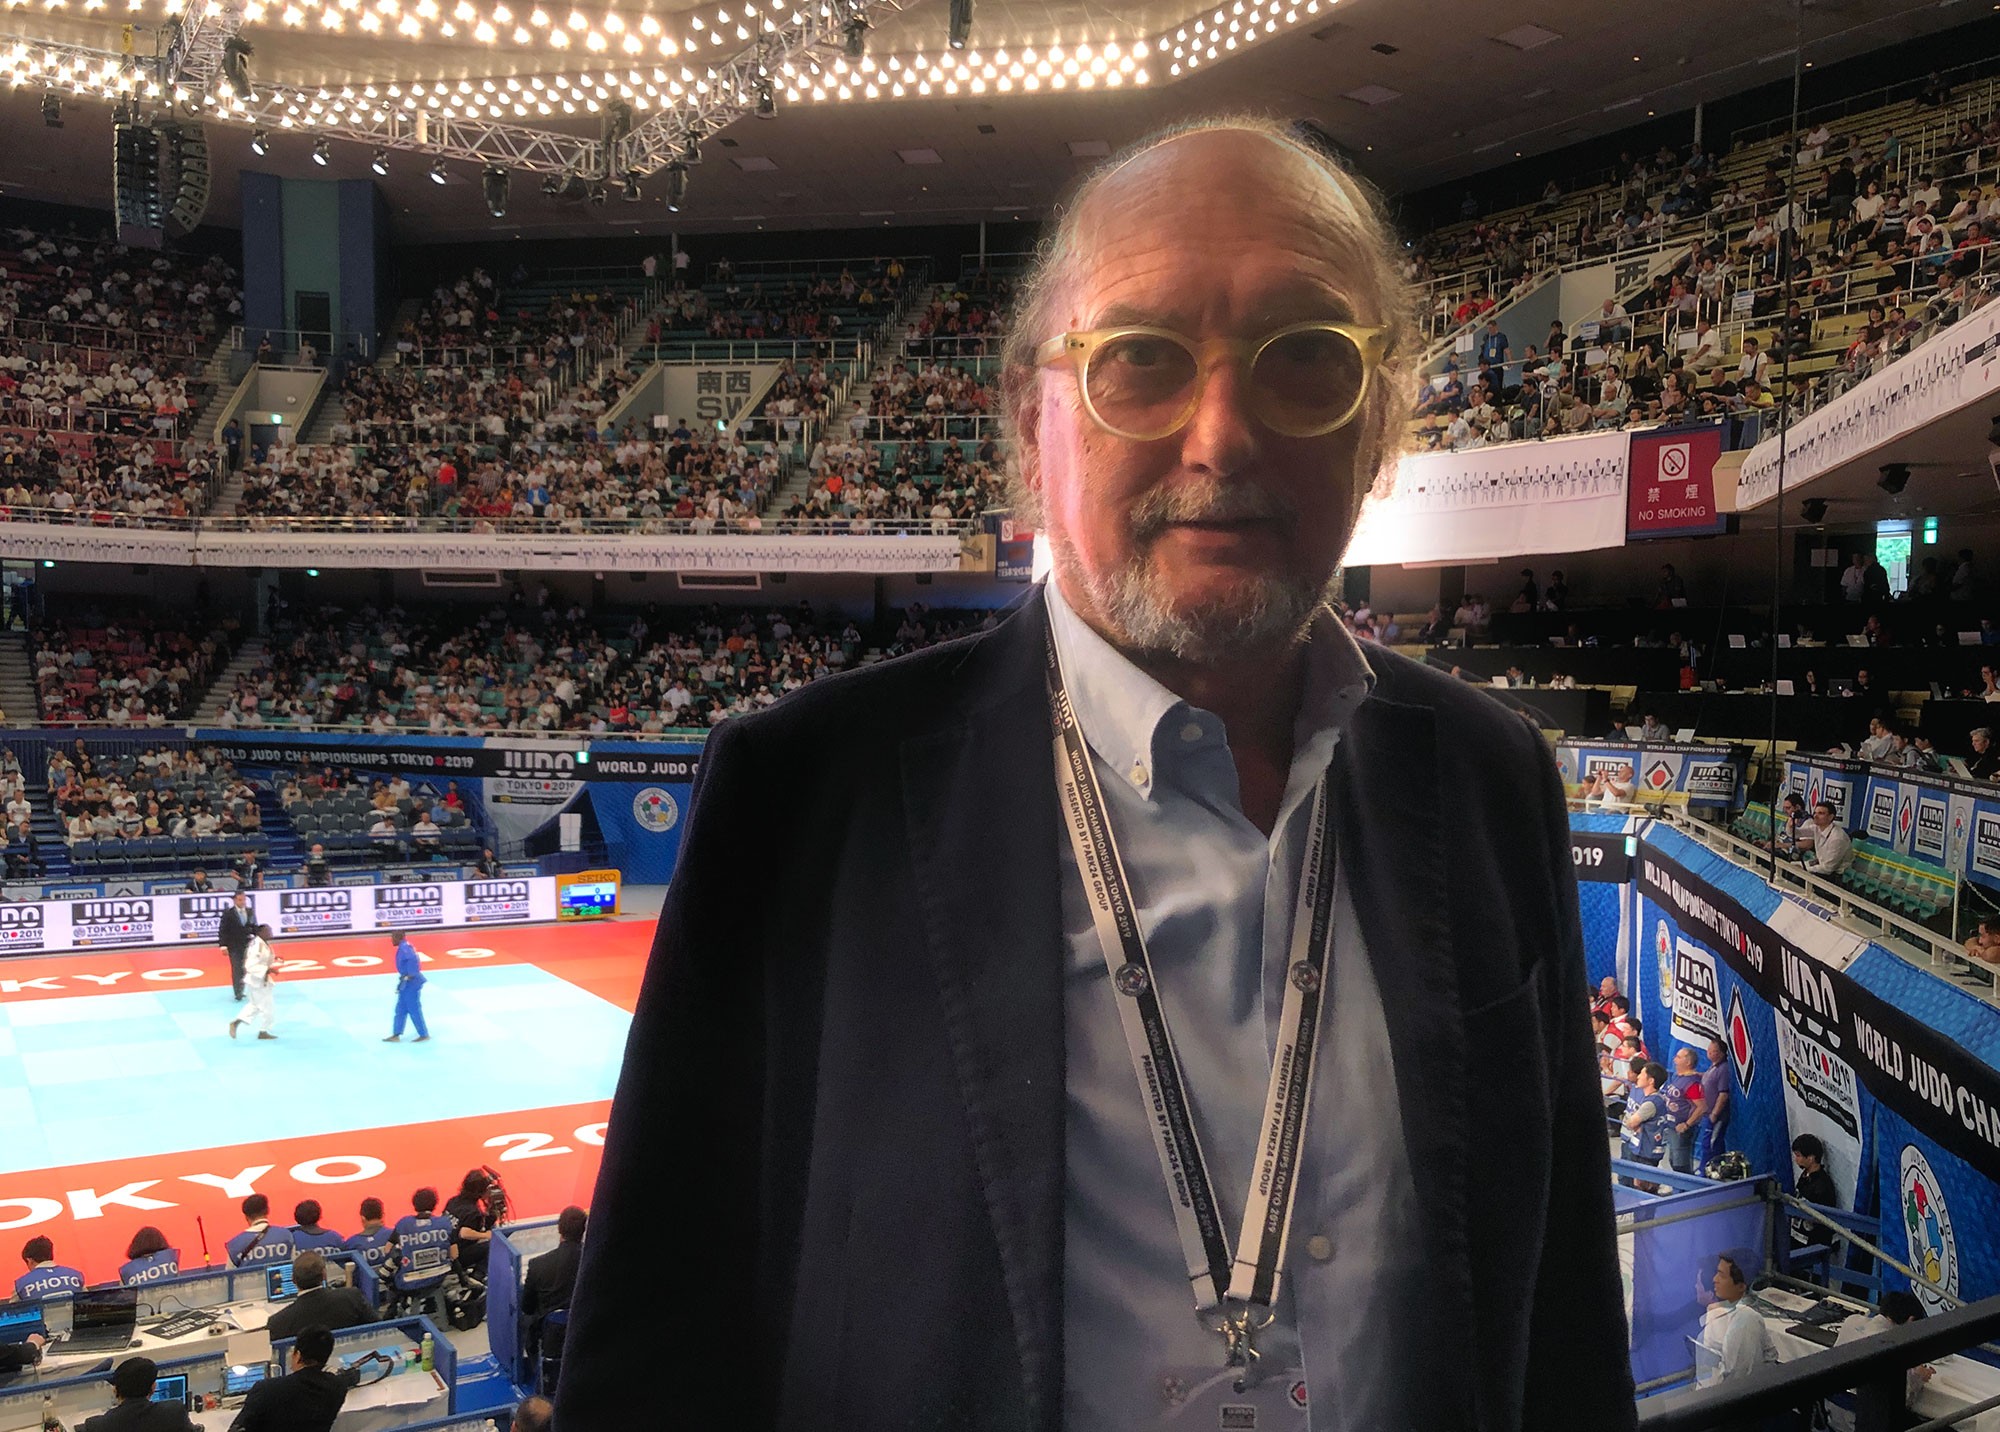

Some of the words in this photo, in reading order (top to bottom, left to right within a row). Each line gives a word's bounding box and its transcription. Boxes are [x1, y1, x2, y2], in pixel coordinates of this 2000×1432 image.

[697, 371, 751, 394] 南西
[697, 397, 751, 420] SW
[1638, 510, 1654, 520] NO
[1657, 506, 1706, 519] SMOKING
[225, 748, 246, 760] RLD
[251, 749, 281, 761] JUDO
[391, 753, 433, 766] TOKYO
[444, 755, 474, 768] 2019
[496, 752, 575, 778] JUDO
[597, 760, 647, 774] WORLD
[651, 762, 687, 775] JUDO
[1069, 748, 1086, 782] WORLD
[507, 780, 542, 790] TOKYO
[1079, 781, 1094, 806] JUDO
[1064, 781, 1085, 830] PRESENTED
[1078, 830, 1088, 843] BY
[1086, 806, 1115, 882] CHAMPIONSHIPS
[1313, 826, 1321, 837] BY
[1082, 843, 1098, 878] PARK24
[1309, 839, 1320, 874] PARK24
[1572, 847, 1603, 866] 019
[578, 873, 616, 883] SEIKO
[284, 891, 348, 912] JUDO
[378, 887, 441, 907] JUDO
[468, 882, 528, 902] JUDO
[1092, 879, 1108, 912] GROUP
[1108, 881, 1125, 914] TOKYO
[1304, 875, 1315, 908] GROUP
[1, 907, 40, 928] DO
[76, 901, 150, 924] JUDO
[476, 903, 504, 911] TOKYO
[19, 930, 43, 938] 2019
[87, 925, 121, 933] TOKYO
[131, 923, 152, 931] 2019
[194, 920, 220, 928] TOKY
[1118, 914, 1131, 938] 2019
[1, 967, 205, 992] KYO
[1779, 945, 1841, 1049] JUDO
[1296, 1017, 1311, 1052] WORLD
[1145, 1017, 1163, 1055] WORLD
[1156, 1057, 1171, 1086] JUDO
[1853, 1012, 1903, 1081] WORLD
[1908, 1053, 1954, 1116] JUDO
[1275, 1044, 1294, 1099] PRESENTED
[1292, 1056, 1305, 1082] JUDO
[1140, 1054, 1163, 1112] PRESENTED
[1156, 1113, 1168, 1127] BY
[1273, 1102, 1282, 1115] BY
[1265, 1117, 1280, 1157] PARK24
[1277, 1084, 1302, 1168] CHAMPIONSHIPS
[1161, 1129, 1179, 1169] PARK24
[1258, 1159, 1272, 1196] GROUP
[1271, 1169, 1286, 1206] TOKYO
[0, 1156, 386, 1230] OKYO
[1173, 1172, 1190, 1209] GROUP
[1266, 1207, 1279, 1233] 2019
[400, 1229, 448, 1246] PHOTO
[25, 1275, 80, 1297] PHOTO
[129, 1262, 178, 1286] PHOTO
